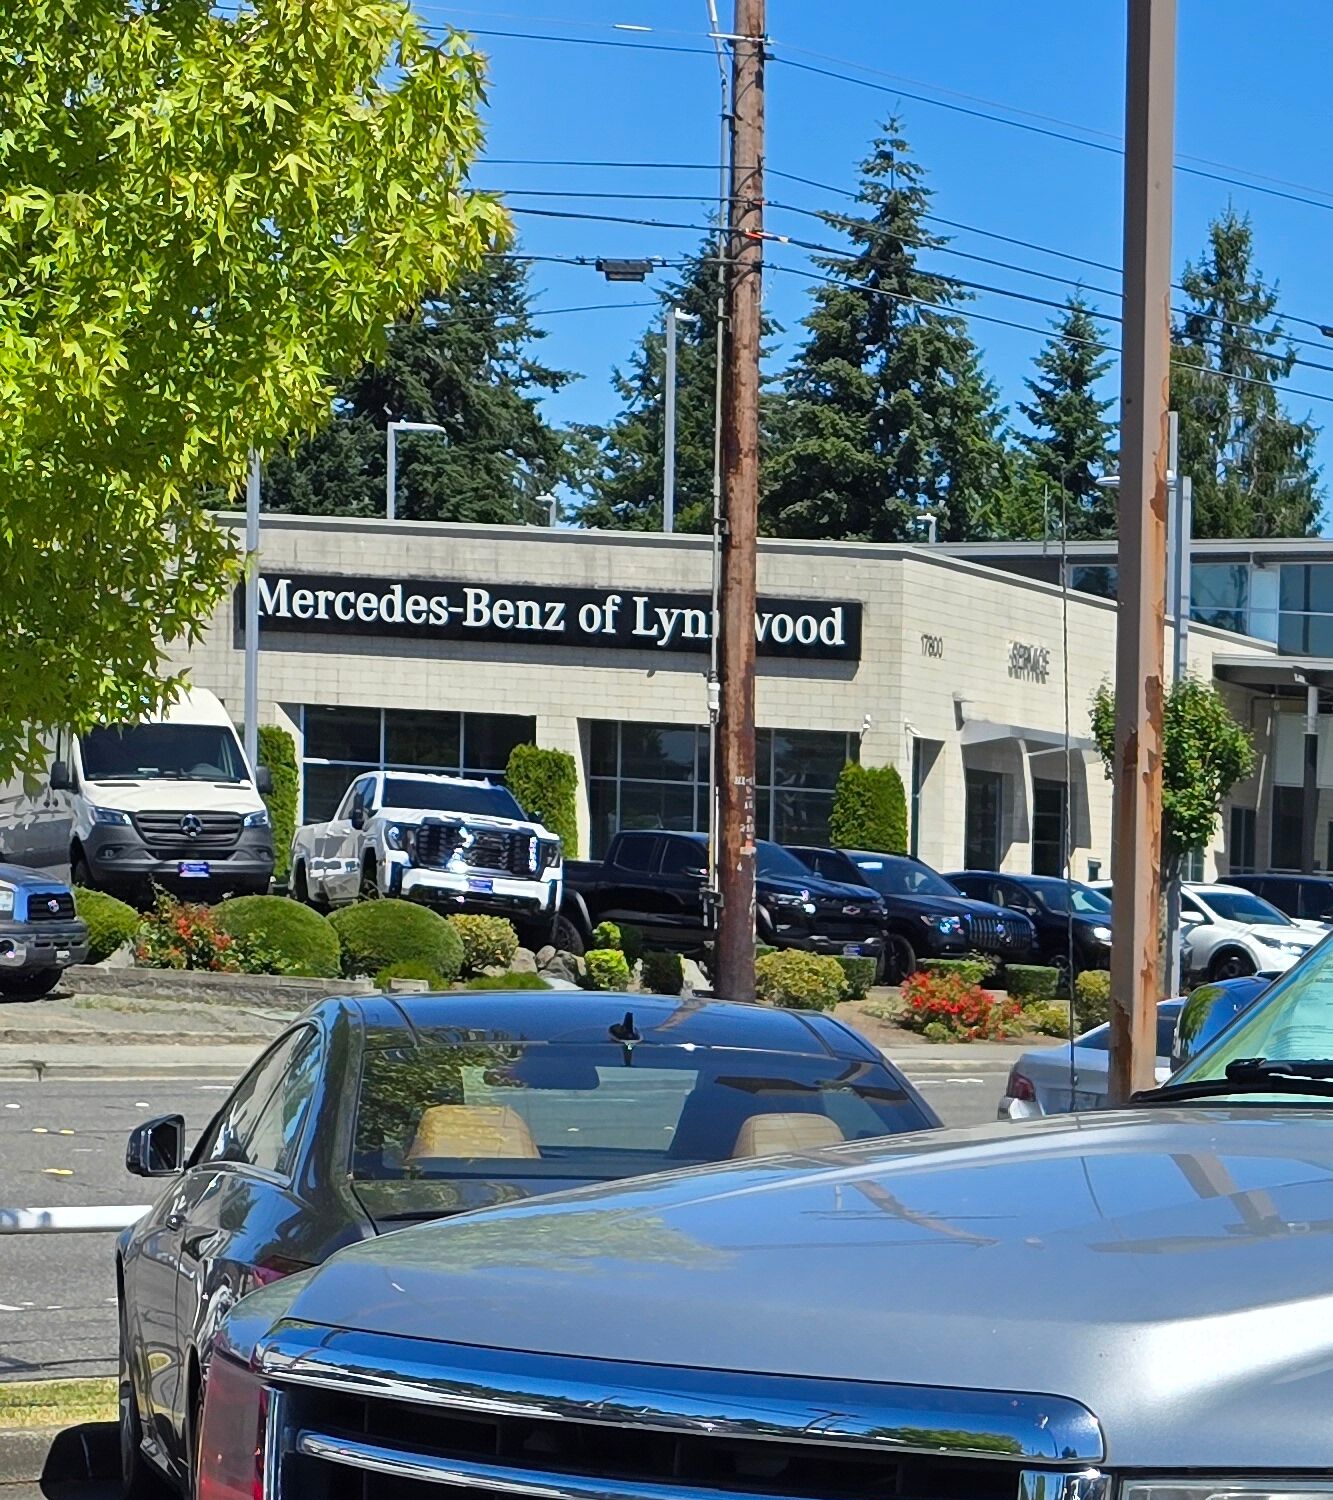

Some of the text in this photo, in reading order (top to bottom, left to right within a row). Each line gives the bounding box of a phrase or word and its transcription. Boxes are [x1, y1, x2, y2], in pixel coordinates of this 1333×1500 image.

[257, 577, 566, 632] Mercedes-Benz
[578, 594, 623, 634] of
[920, 634, 944, 659] 17800
